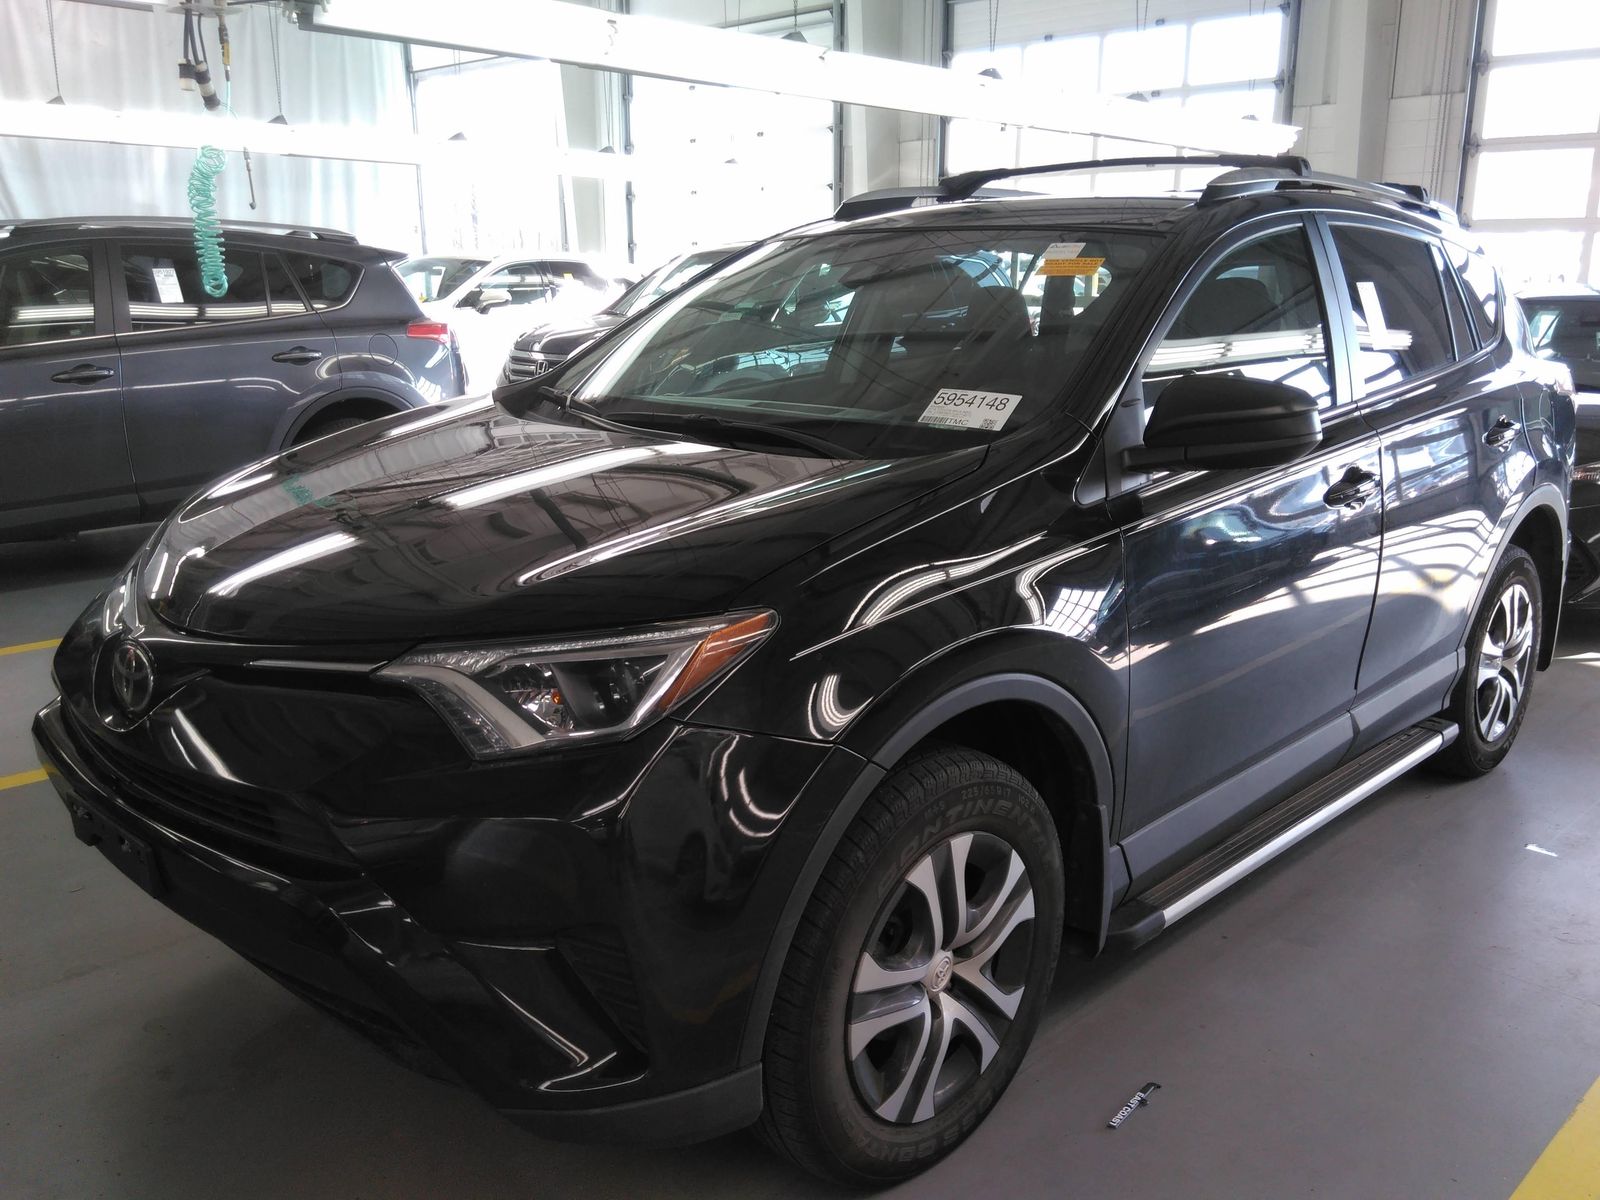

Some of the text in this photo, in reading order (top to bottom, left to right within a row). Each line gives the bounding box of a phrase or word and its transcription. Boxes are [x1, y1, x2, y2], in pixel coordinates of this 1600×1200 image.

[933, 391, 1010, 411] 5954148
[1109, 1091, 1145, 1126] EAST COAST
